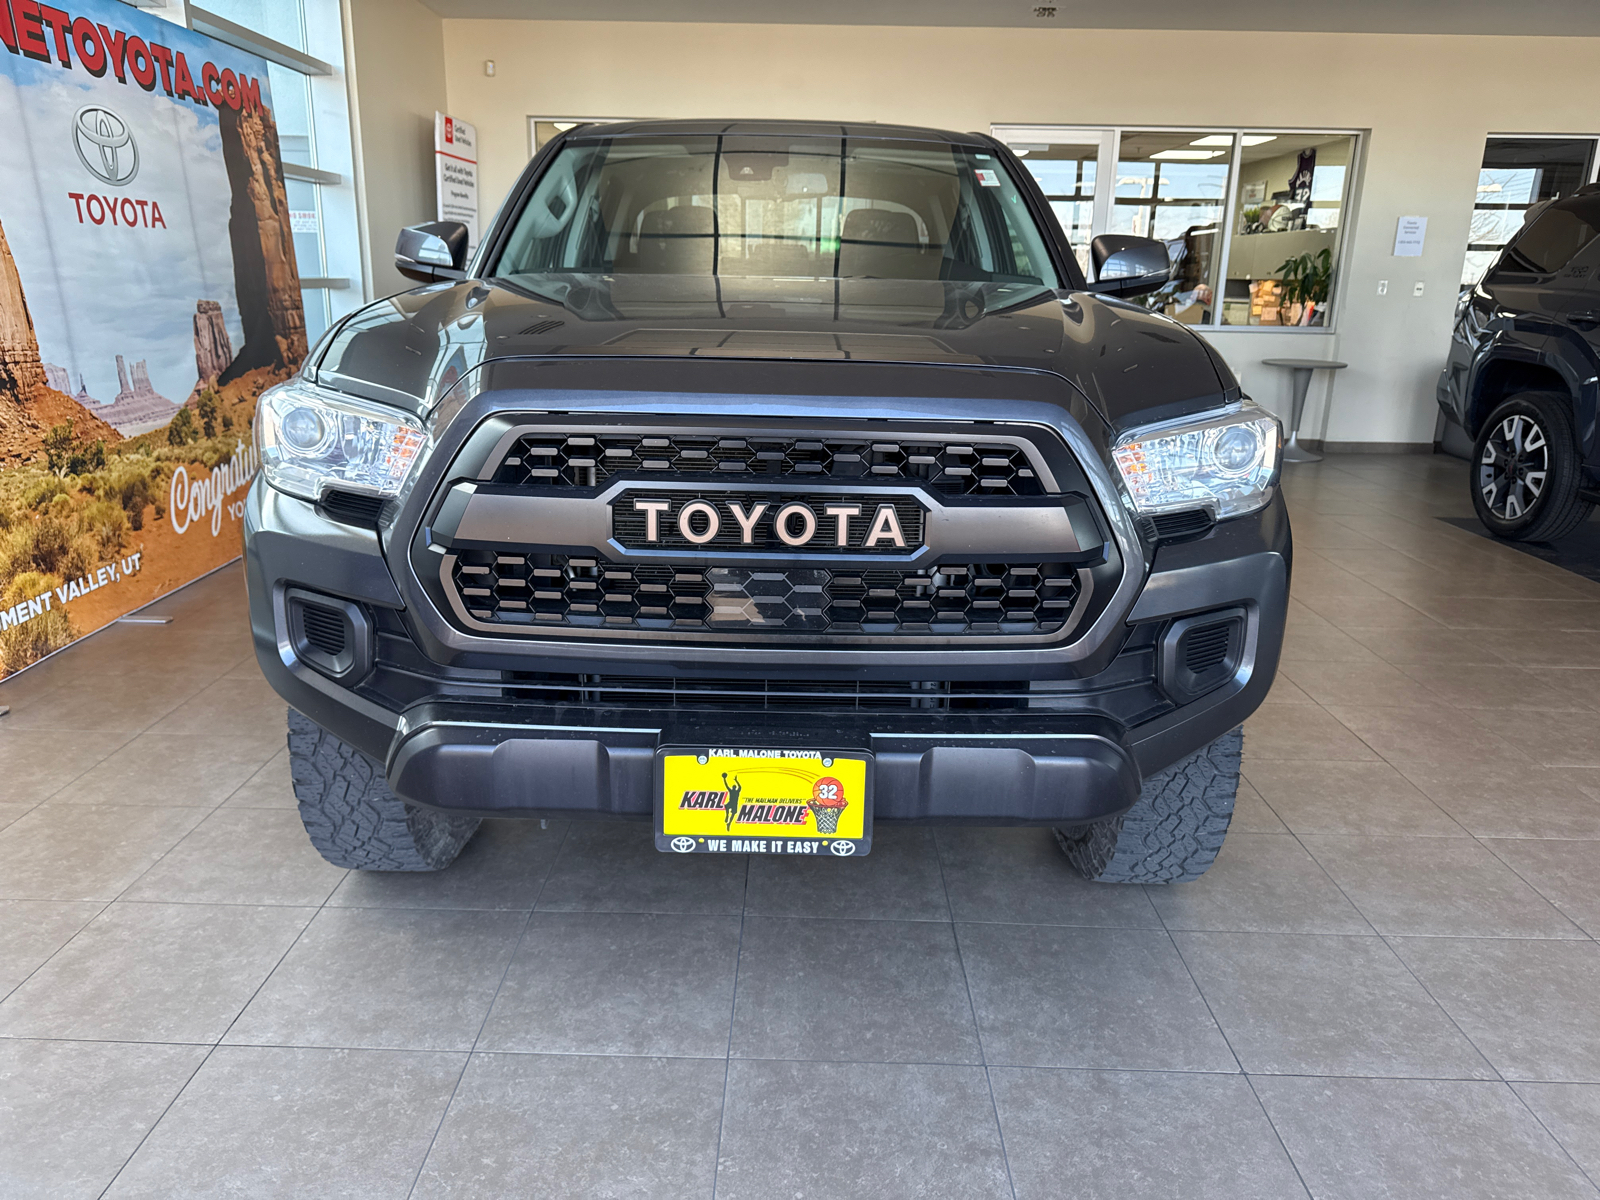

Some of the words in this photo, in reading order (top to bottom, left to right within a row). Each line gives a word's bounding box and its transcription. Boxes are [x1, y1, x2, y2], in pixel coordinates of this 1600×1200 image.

[68, 192, 167, 229] TOYOTA
[227, 498, 246, 521] YO
[633, 498, 907, 548] TOYOTA
[0, 591, 52, 631] MENT
[56, 563, 120, 604] VALLEY,
[121, 552, 141, 575] UT
[708, 748, 737, 758] KARL
[739, 749, 781, 759] MALONE
[783, 750, 823, 760] TOYOTA
[679, 790, 727, 811] KARL
[818, 784, 838, 800] 32
[735, 804, 812, 826] MALONE
[707, 839, 727, 852] WE
[731, 840, 767, 853] MAKE
[771, 840, 784, 853] IT
[787, 841, 819, 854] EASY
